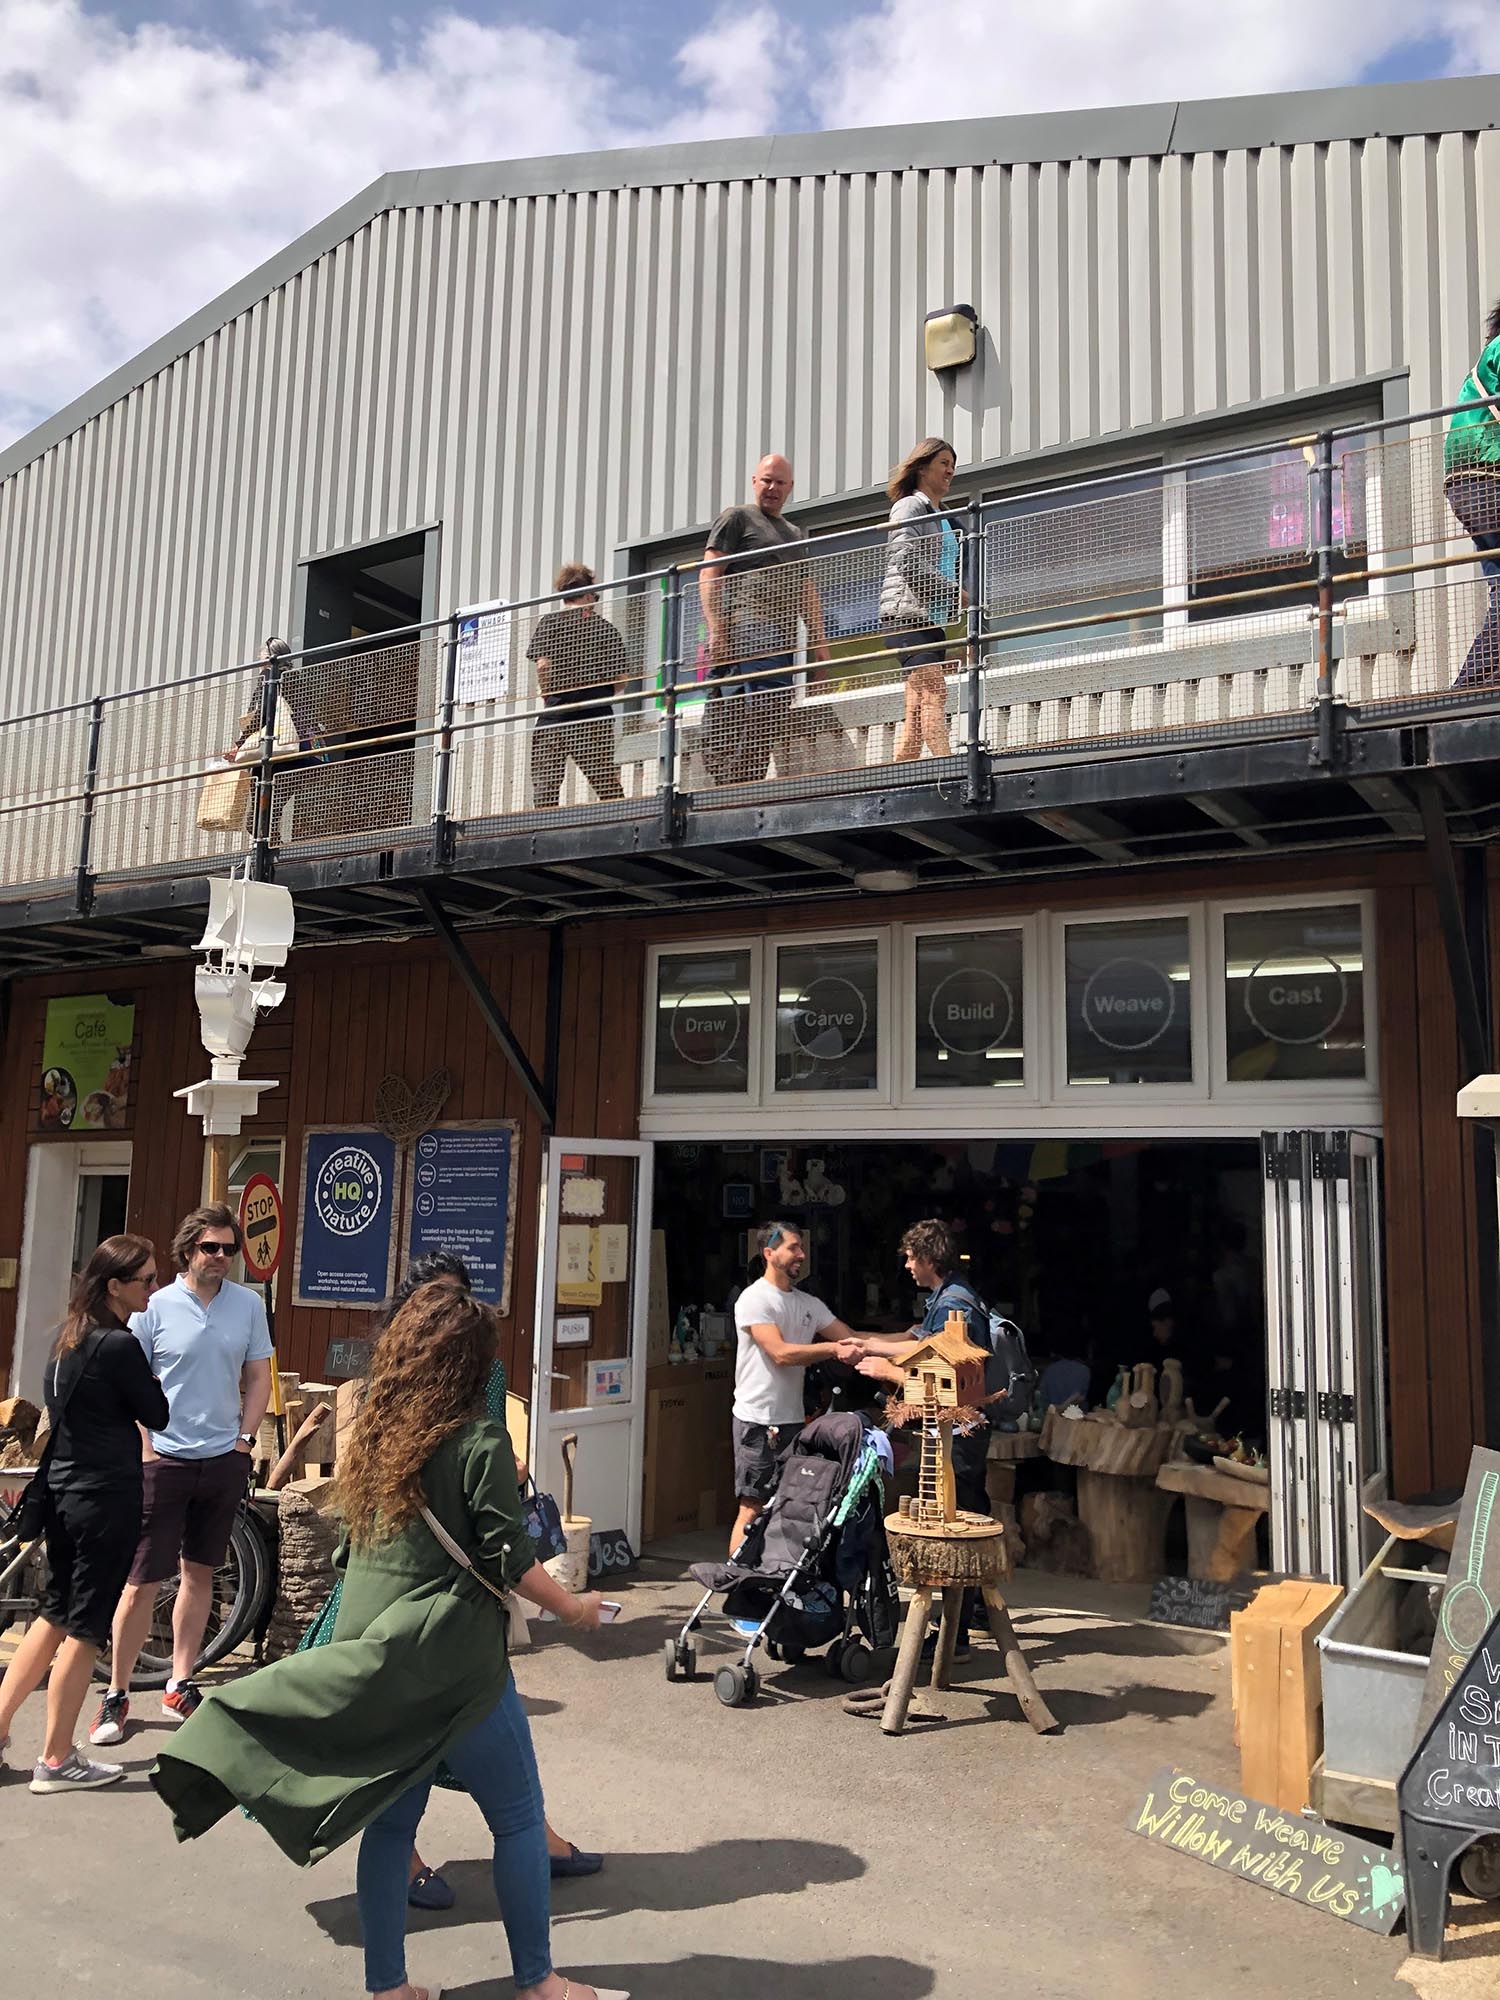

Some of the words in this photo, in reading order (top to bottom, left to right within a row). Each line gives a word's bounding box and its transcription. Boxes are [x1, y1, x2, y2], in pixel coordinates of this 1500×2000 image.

[1268, 985, 1322, 1006] Cast
[947, 1004, 994, 1021] Build
[1094, 997, 1163, 1014] Weave
[685, 1016, 726, 1033] Draw
[804, 1009, 855, 1027] Carve
[75, 1020, 106, 1039] Café
[323, 1153, 374, 1185] creative
[334, 1182, 361, 1201] HQ
[247, 1196, 273, 1221] STOP
[323, 1203, 371, 1230] nature
[421, 1235, 448, 1243] overlooking
[316, 1270, 328, 1278] Open
[344, 1272, 368, 1280] community
[561, 1323, 585, 1336] PUSH
[1169, 1776, 1247, 1823] Come
[1136, 1792, 1232, 1862] Willow
[1230, 1843, 1303, 1894] with
